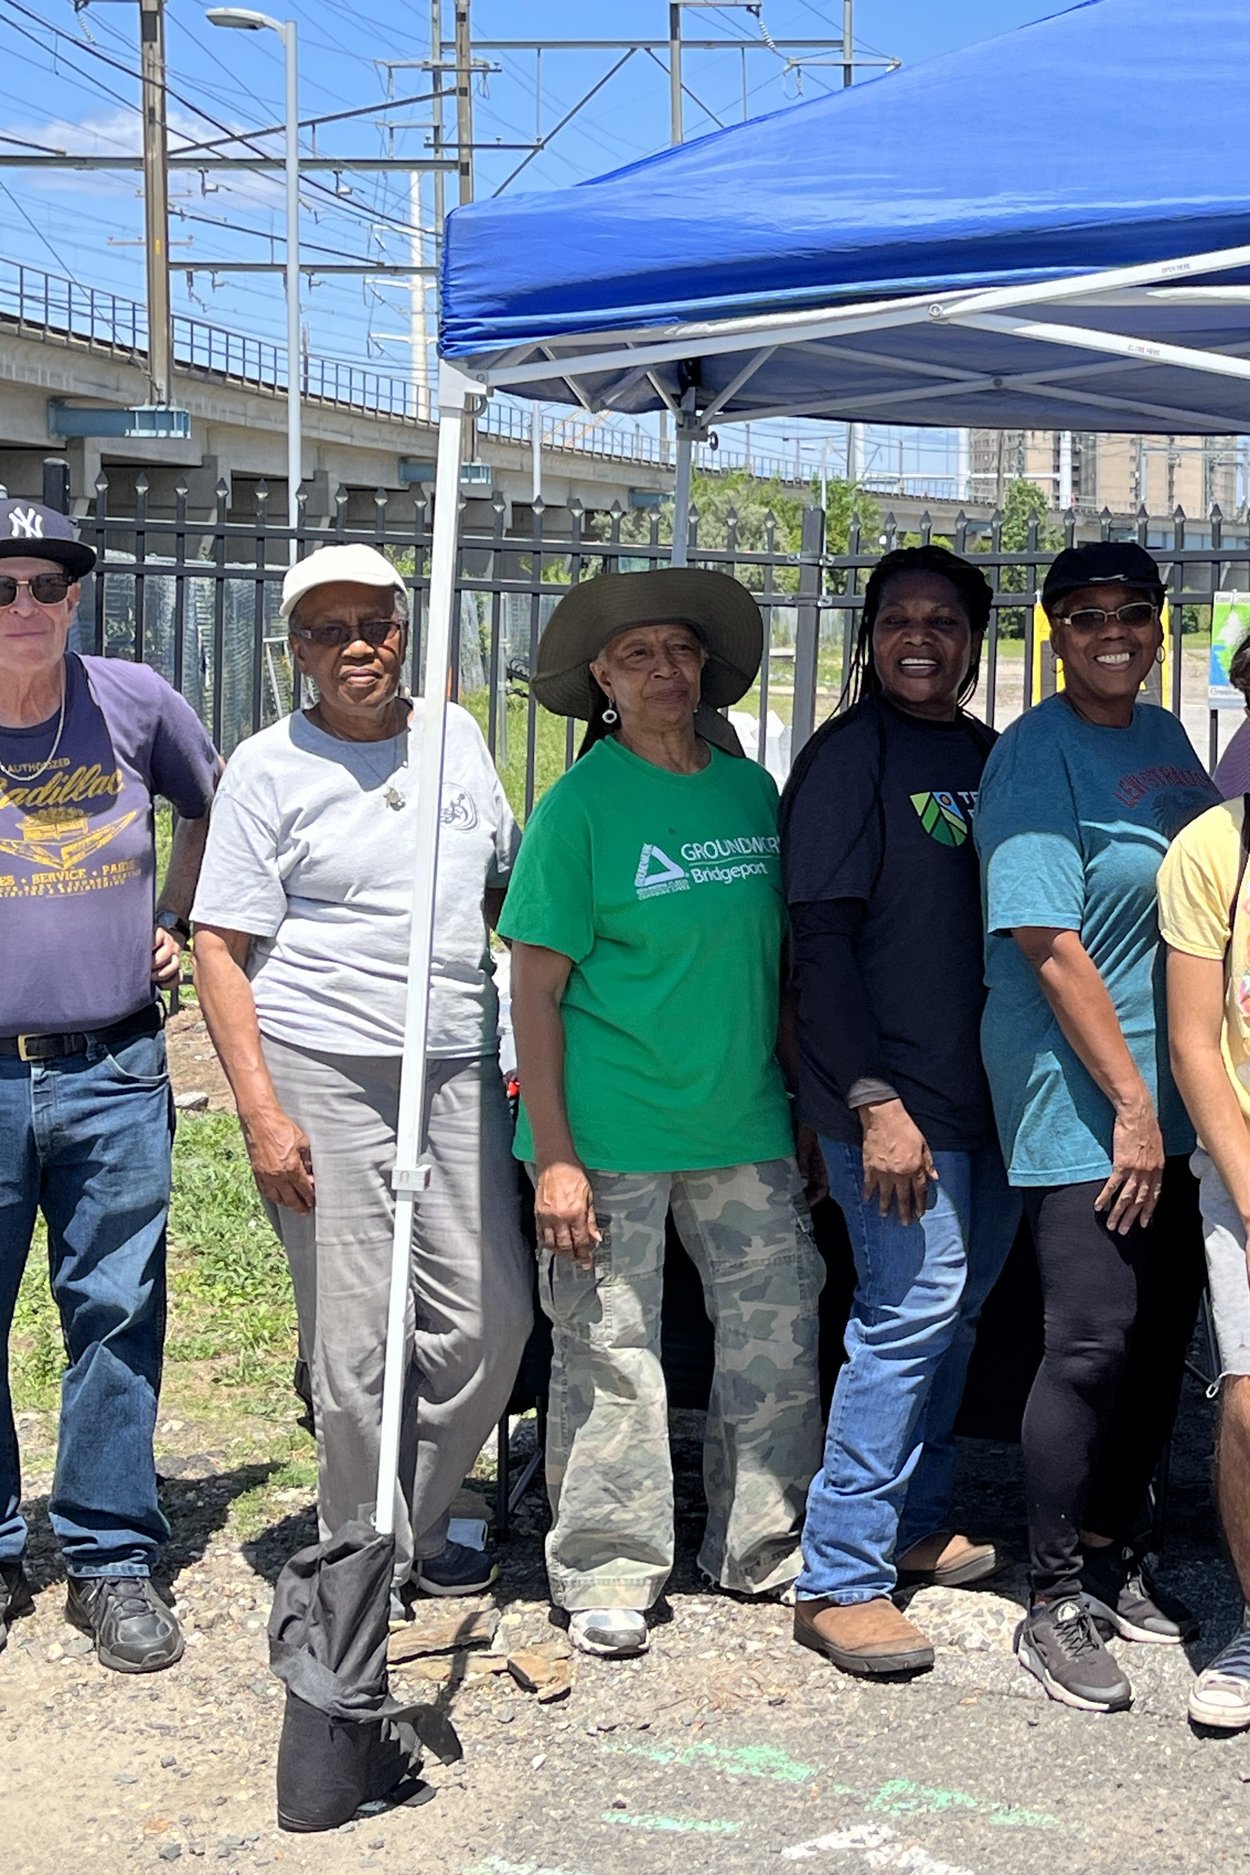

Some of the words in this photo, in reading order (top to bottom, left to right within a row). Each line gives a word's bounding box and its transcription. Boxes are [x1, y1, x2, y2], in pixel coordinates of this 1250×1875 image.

[9, 507, 43, 538] NY
[8, 757, 70, 773] AUTHOIZED
[681, 835, 780, 861] GROUNDWOR
[691, 862, 768, 885] Bridgeport
